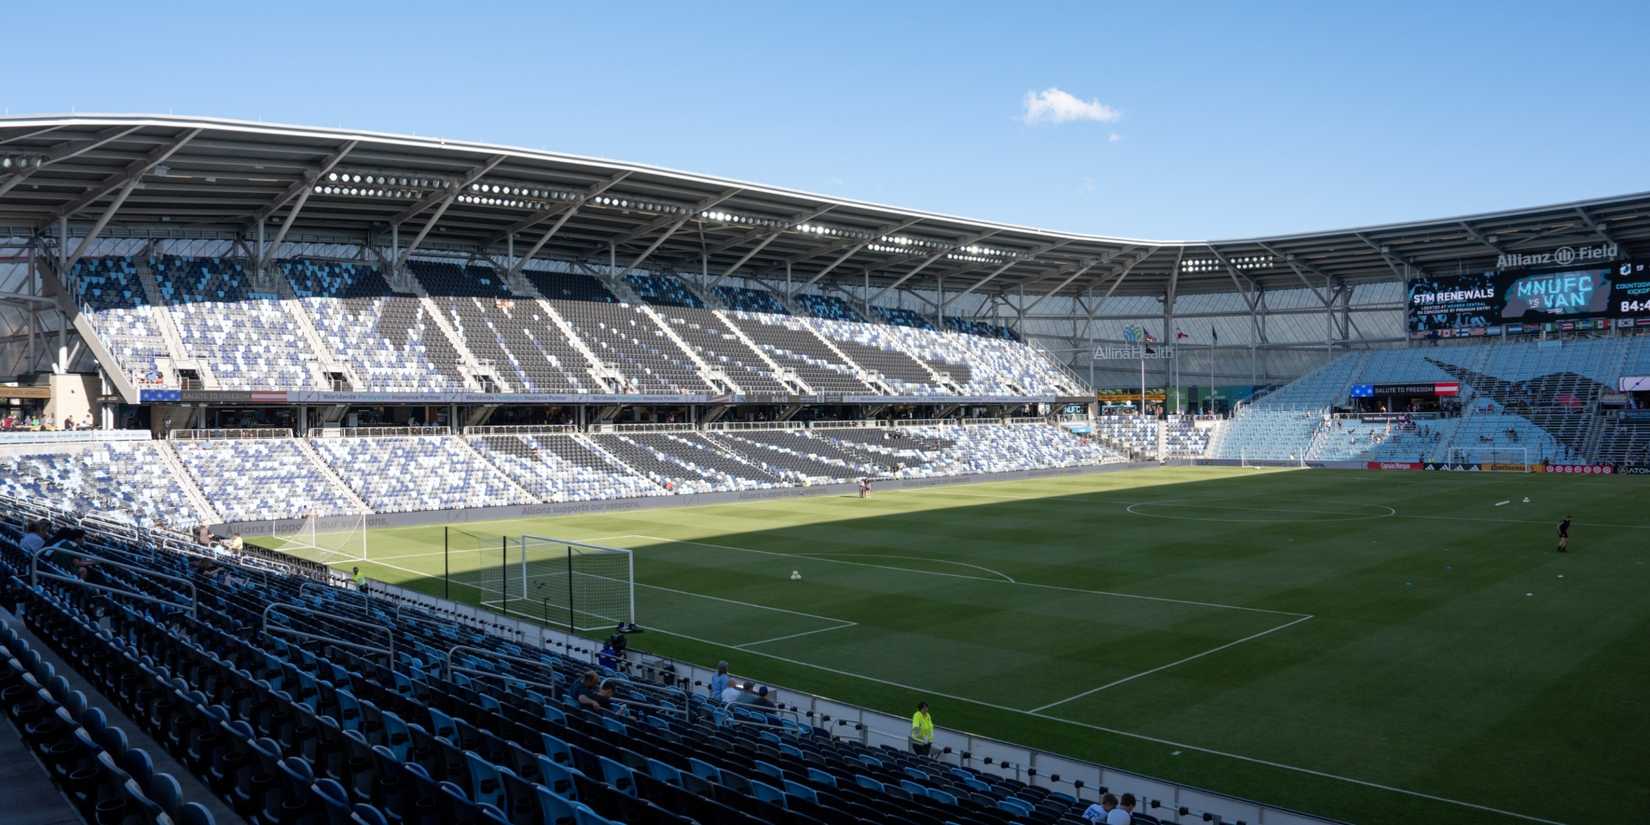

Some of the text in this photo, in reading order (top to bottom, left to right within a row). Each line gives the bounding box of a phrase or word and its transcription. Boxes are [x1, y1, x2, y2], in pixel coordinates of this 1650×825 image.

[1496, 243, 1618, 268] Allianz Field
[1517, 276, 1593, 297] MNUFC
[1413, 288, 1495, 304] STM RENEWALS
[1544, 292, 1585, 308] VAN
[1094, 344, 1177, 360] Allina Health
